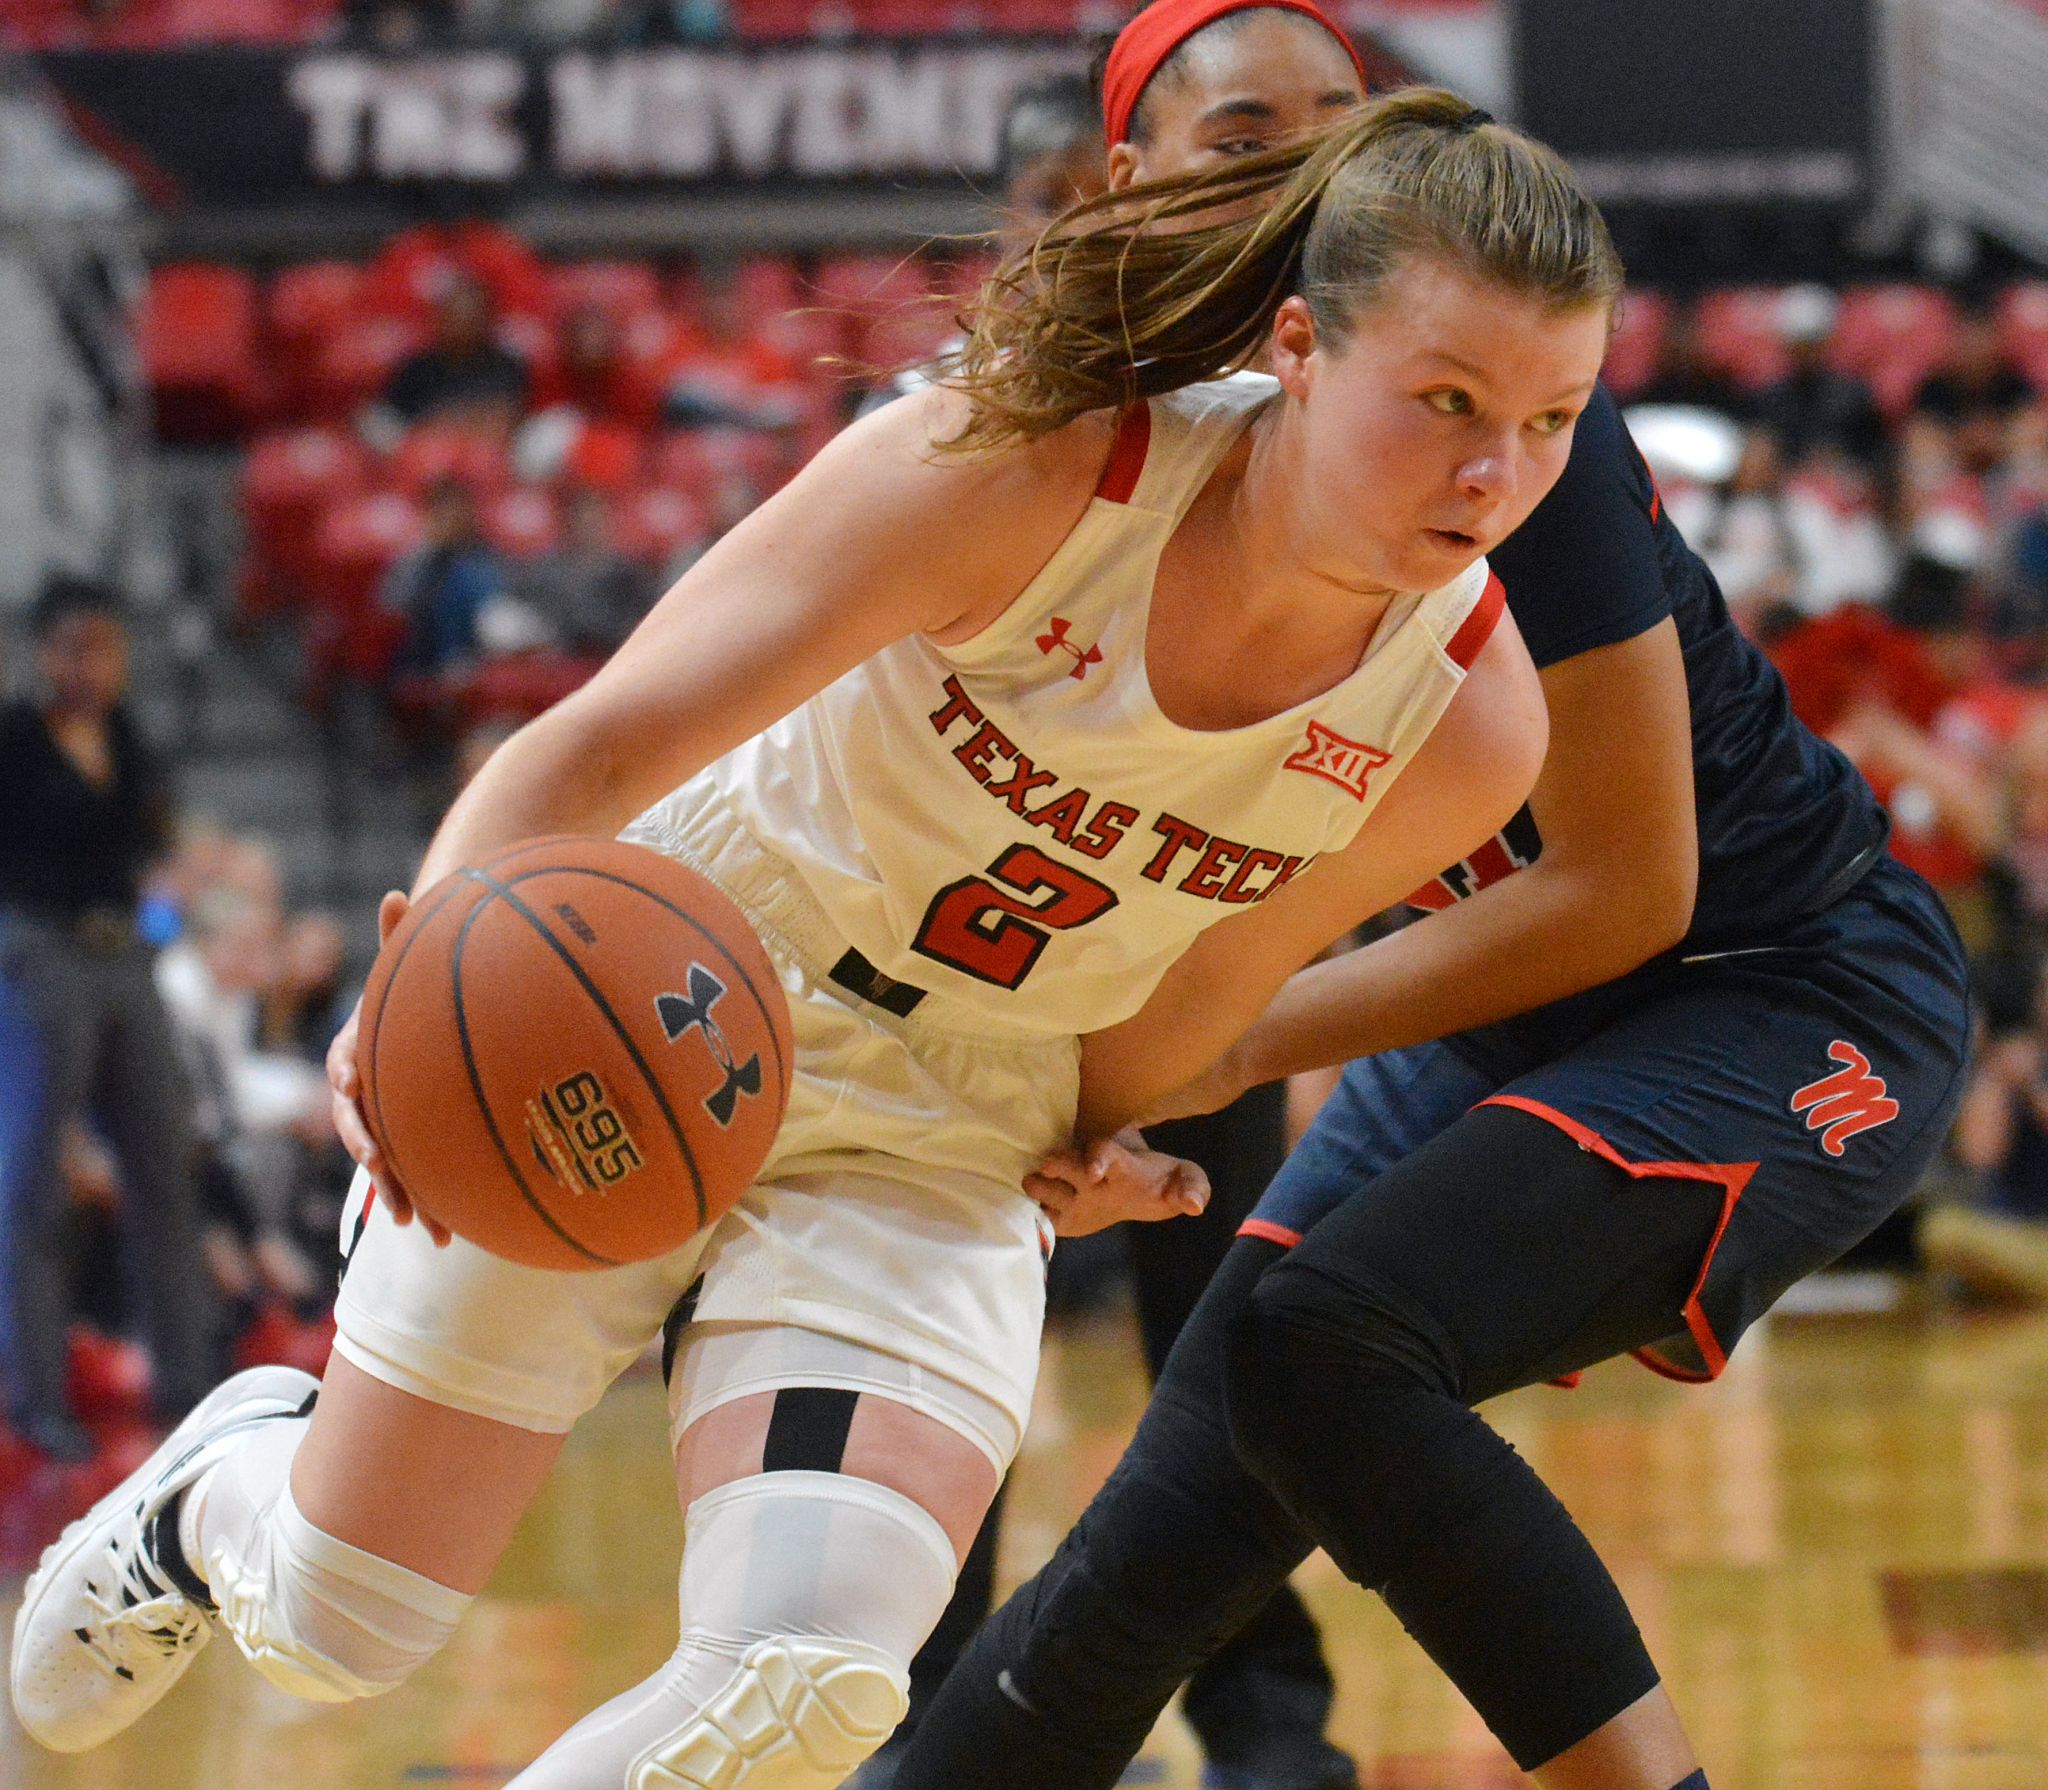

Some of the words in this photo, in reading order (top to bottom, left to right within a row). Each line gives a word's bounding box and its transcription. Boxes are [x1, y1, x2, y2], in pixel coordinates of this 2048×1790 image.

[929, 674, 1140, 860] TEXAS
[1288, 725, 1388, 797] XII
[911, 842, 1119, 990] 2
[555, 1070, 643, 1184] 695
